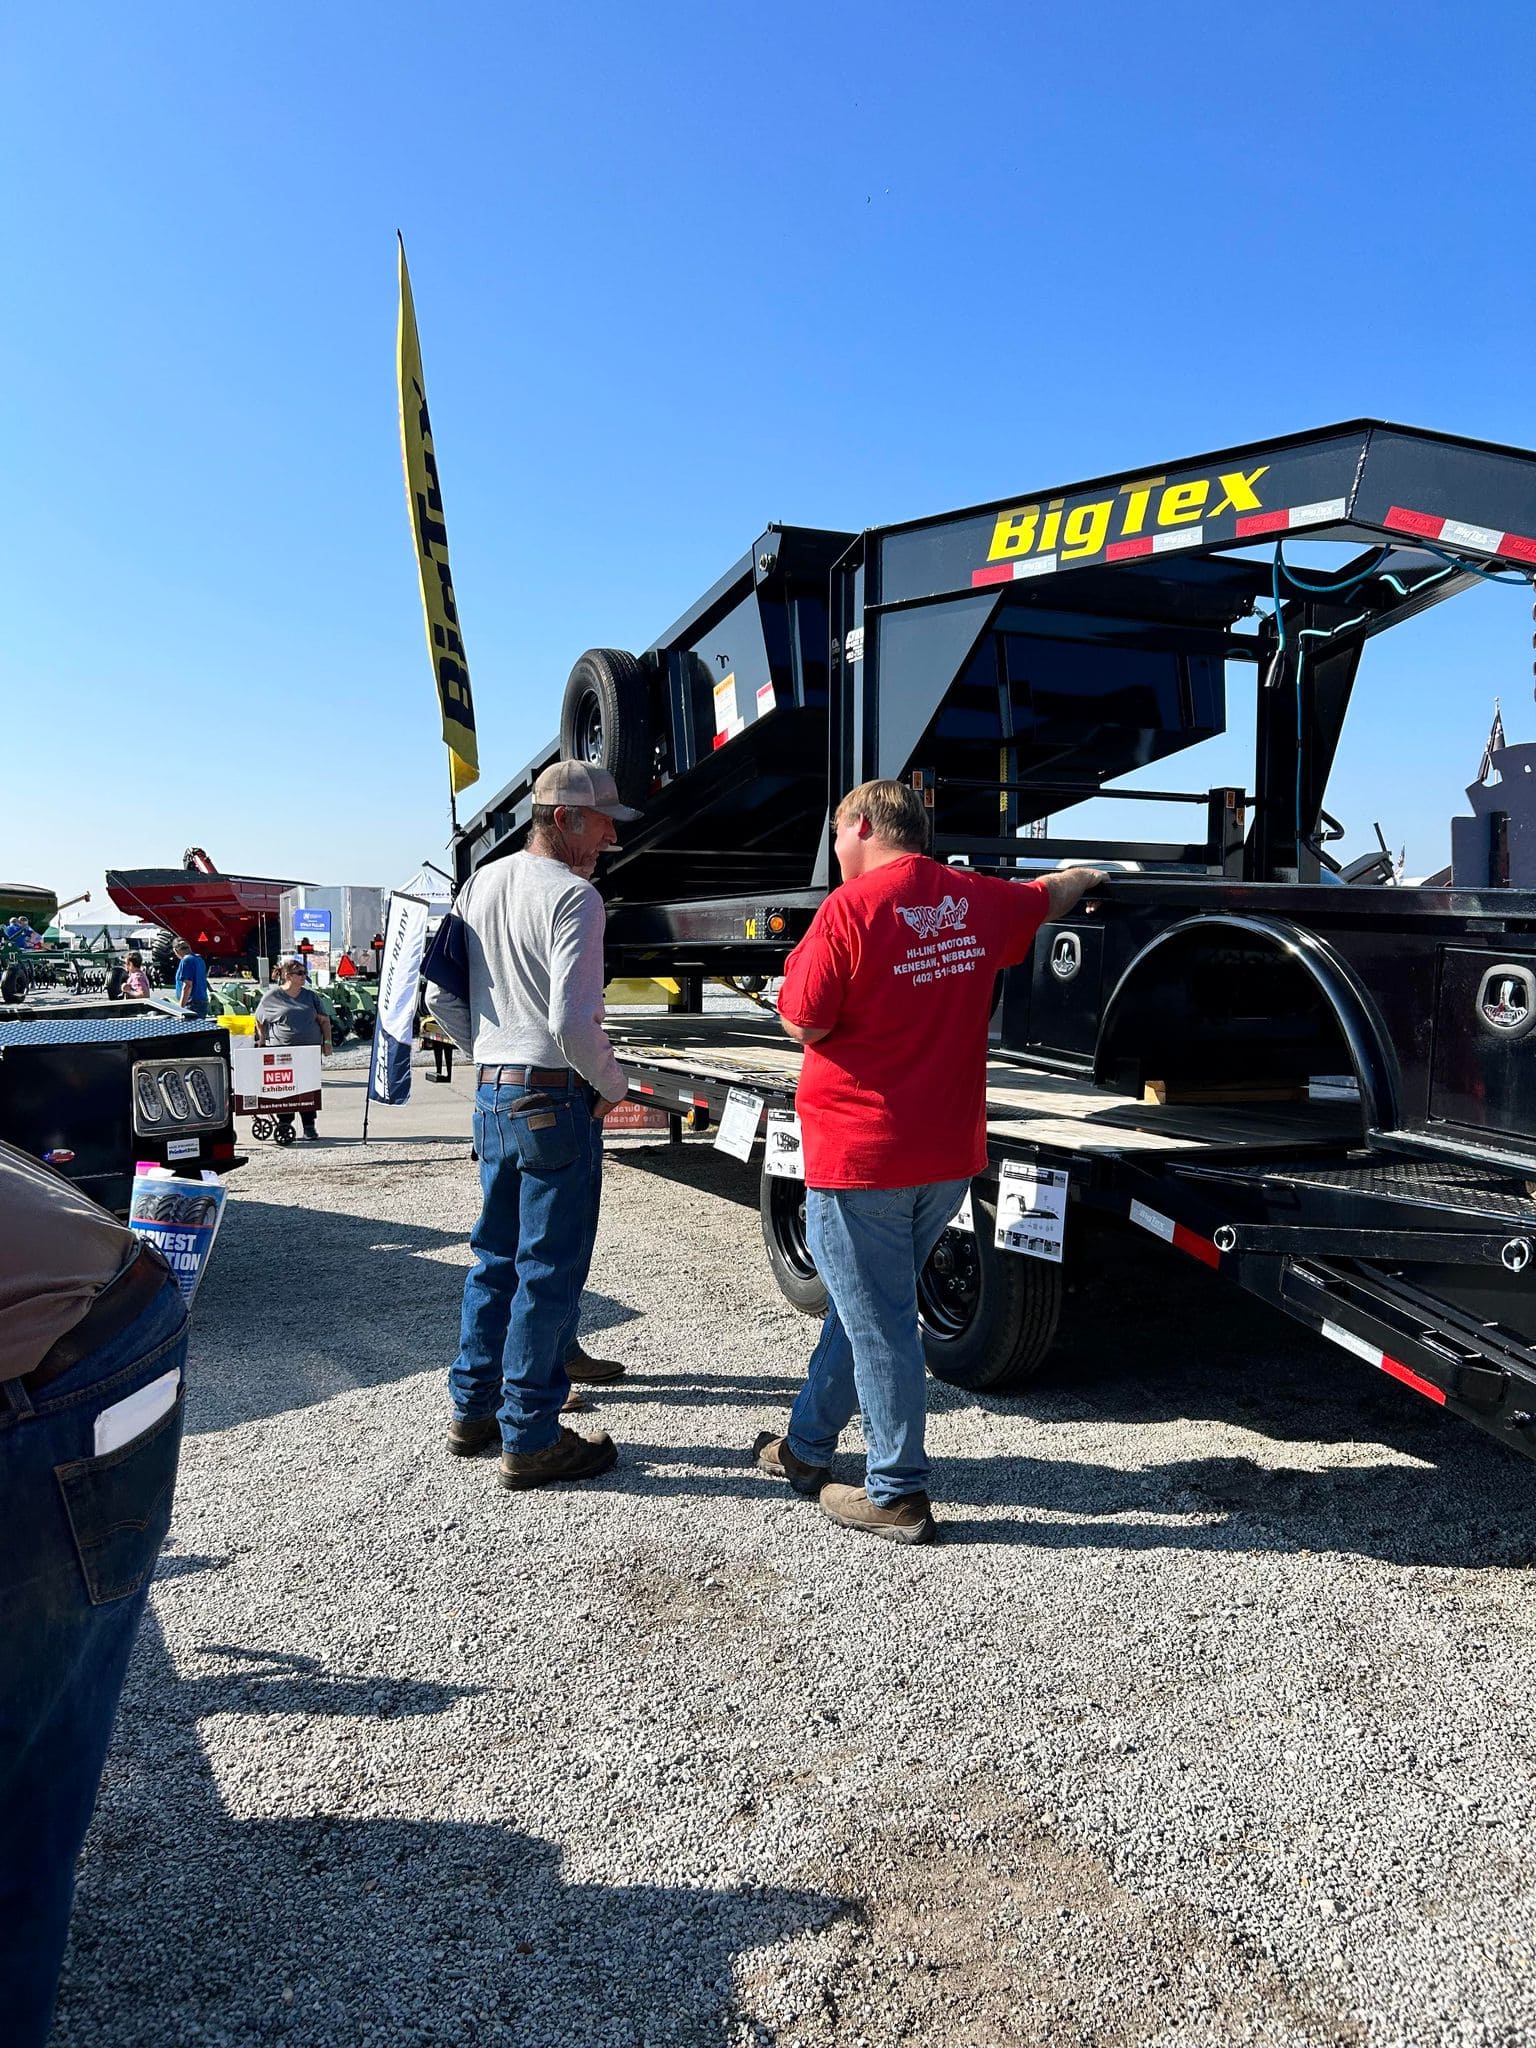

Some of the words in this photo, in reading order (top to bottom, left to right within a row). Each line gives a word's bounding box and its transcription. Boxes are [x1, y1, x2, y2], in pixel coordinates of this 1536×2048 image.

[986, 465, 1270, 562] BigTex
[745, 918, 756, 940] 14
[383, 962, 395, 1011] WORK
[393, 907, 409, 961] READY
[906, 944, 936, 959] HI-LINE
[937, 935, 977, 953] MOTORS
[893, 957, 940, 975] KENESAW,
[941, 947, 986, 964] NEBRASKA
[262, 1085, 296, 1093] Exhibitor
[265, 1071, 292, 1083] NEW
